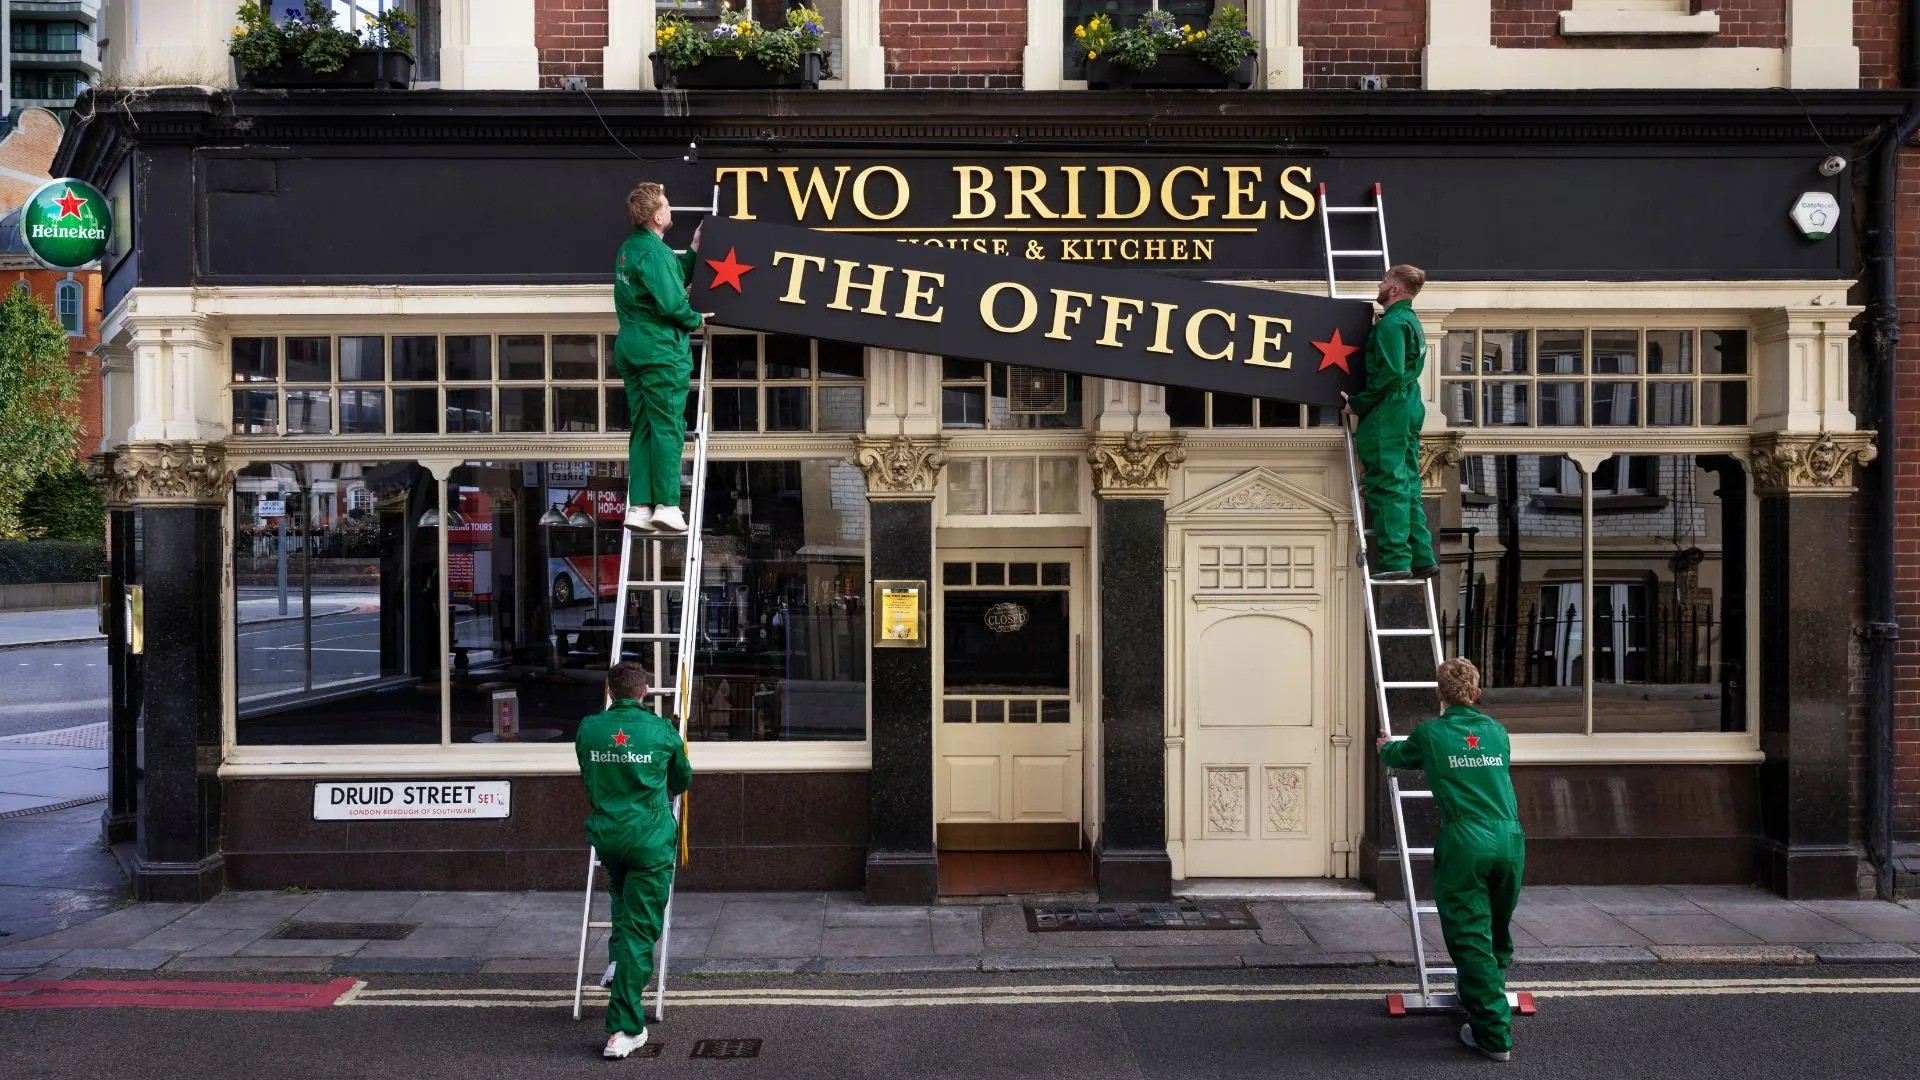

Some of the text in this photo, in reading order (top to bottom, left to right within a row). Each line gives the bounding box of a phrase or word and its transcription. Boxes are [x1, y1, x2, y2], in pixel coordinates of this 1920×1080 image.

[716, 165, 1316, 220] TWO BRIDGES
[32, 224, 105, 239] Heineken
[897, 239, 1215, 260] USE & KITCHEN
[772, 251, 1293, 369] THE OFFICE
[471, 523, 493, 531] TOURS
[988, 614, 1025, 626] CLOSED
[590, 750, 653, 764] Heineken
[1448, 753, 1503, 768] Heineken
[330, 785, 494, 805] DRUID STREET SE1
